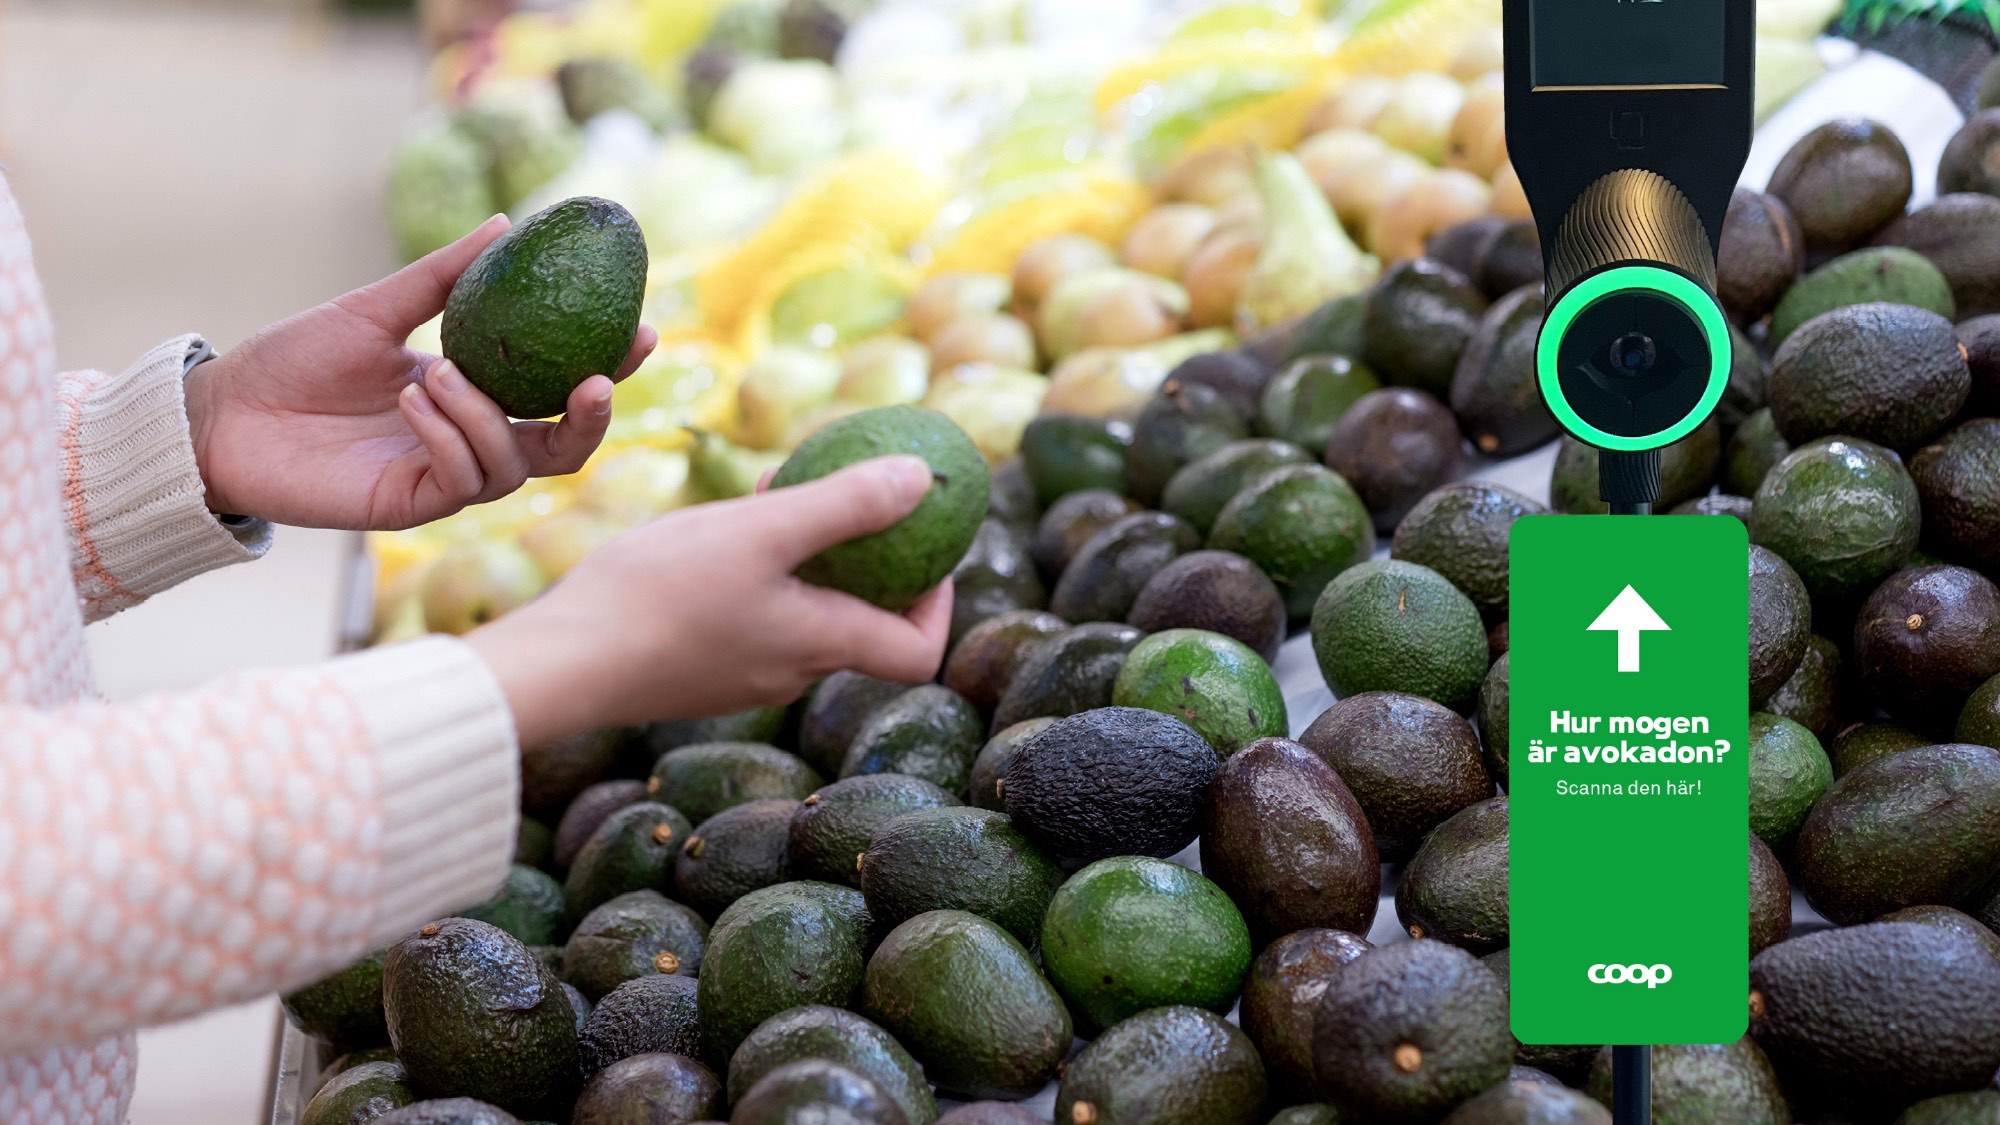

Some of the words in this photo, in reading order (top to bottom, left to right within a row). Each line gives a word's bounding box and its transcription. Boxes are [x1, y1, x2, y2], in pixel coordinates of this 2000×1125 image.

[1550, 710, 1602, 734] Hur
[1609, 715, 1709, 740] mogen
[1527, 739, 1558, 763] är
[1563, 739, 1731, 764] avokadon?
[1556, 779, 1623, 795] Scanna
[1628, 779, 1661, 795] den
[1667, 779, 1701, 795] här!
[1587, 963, 1673, 989] coop
